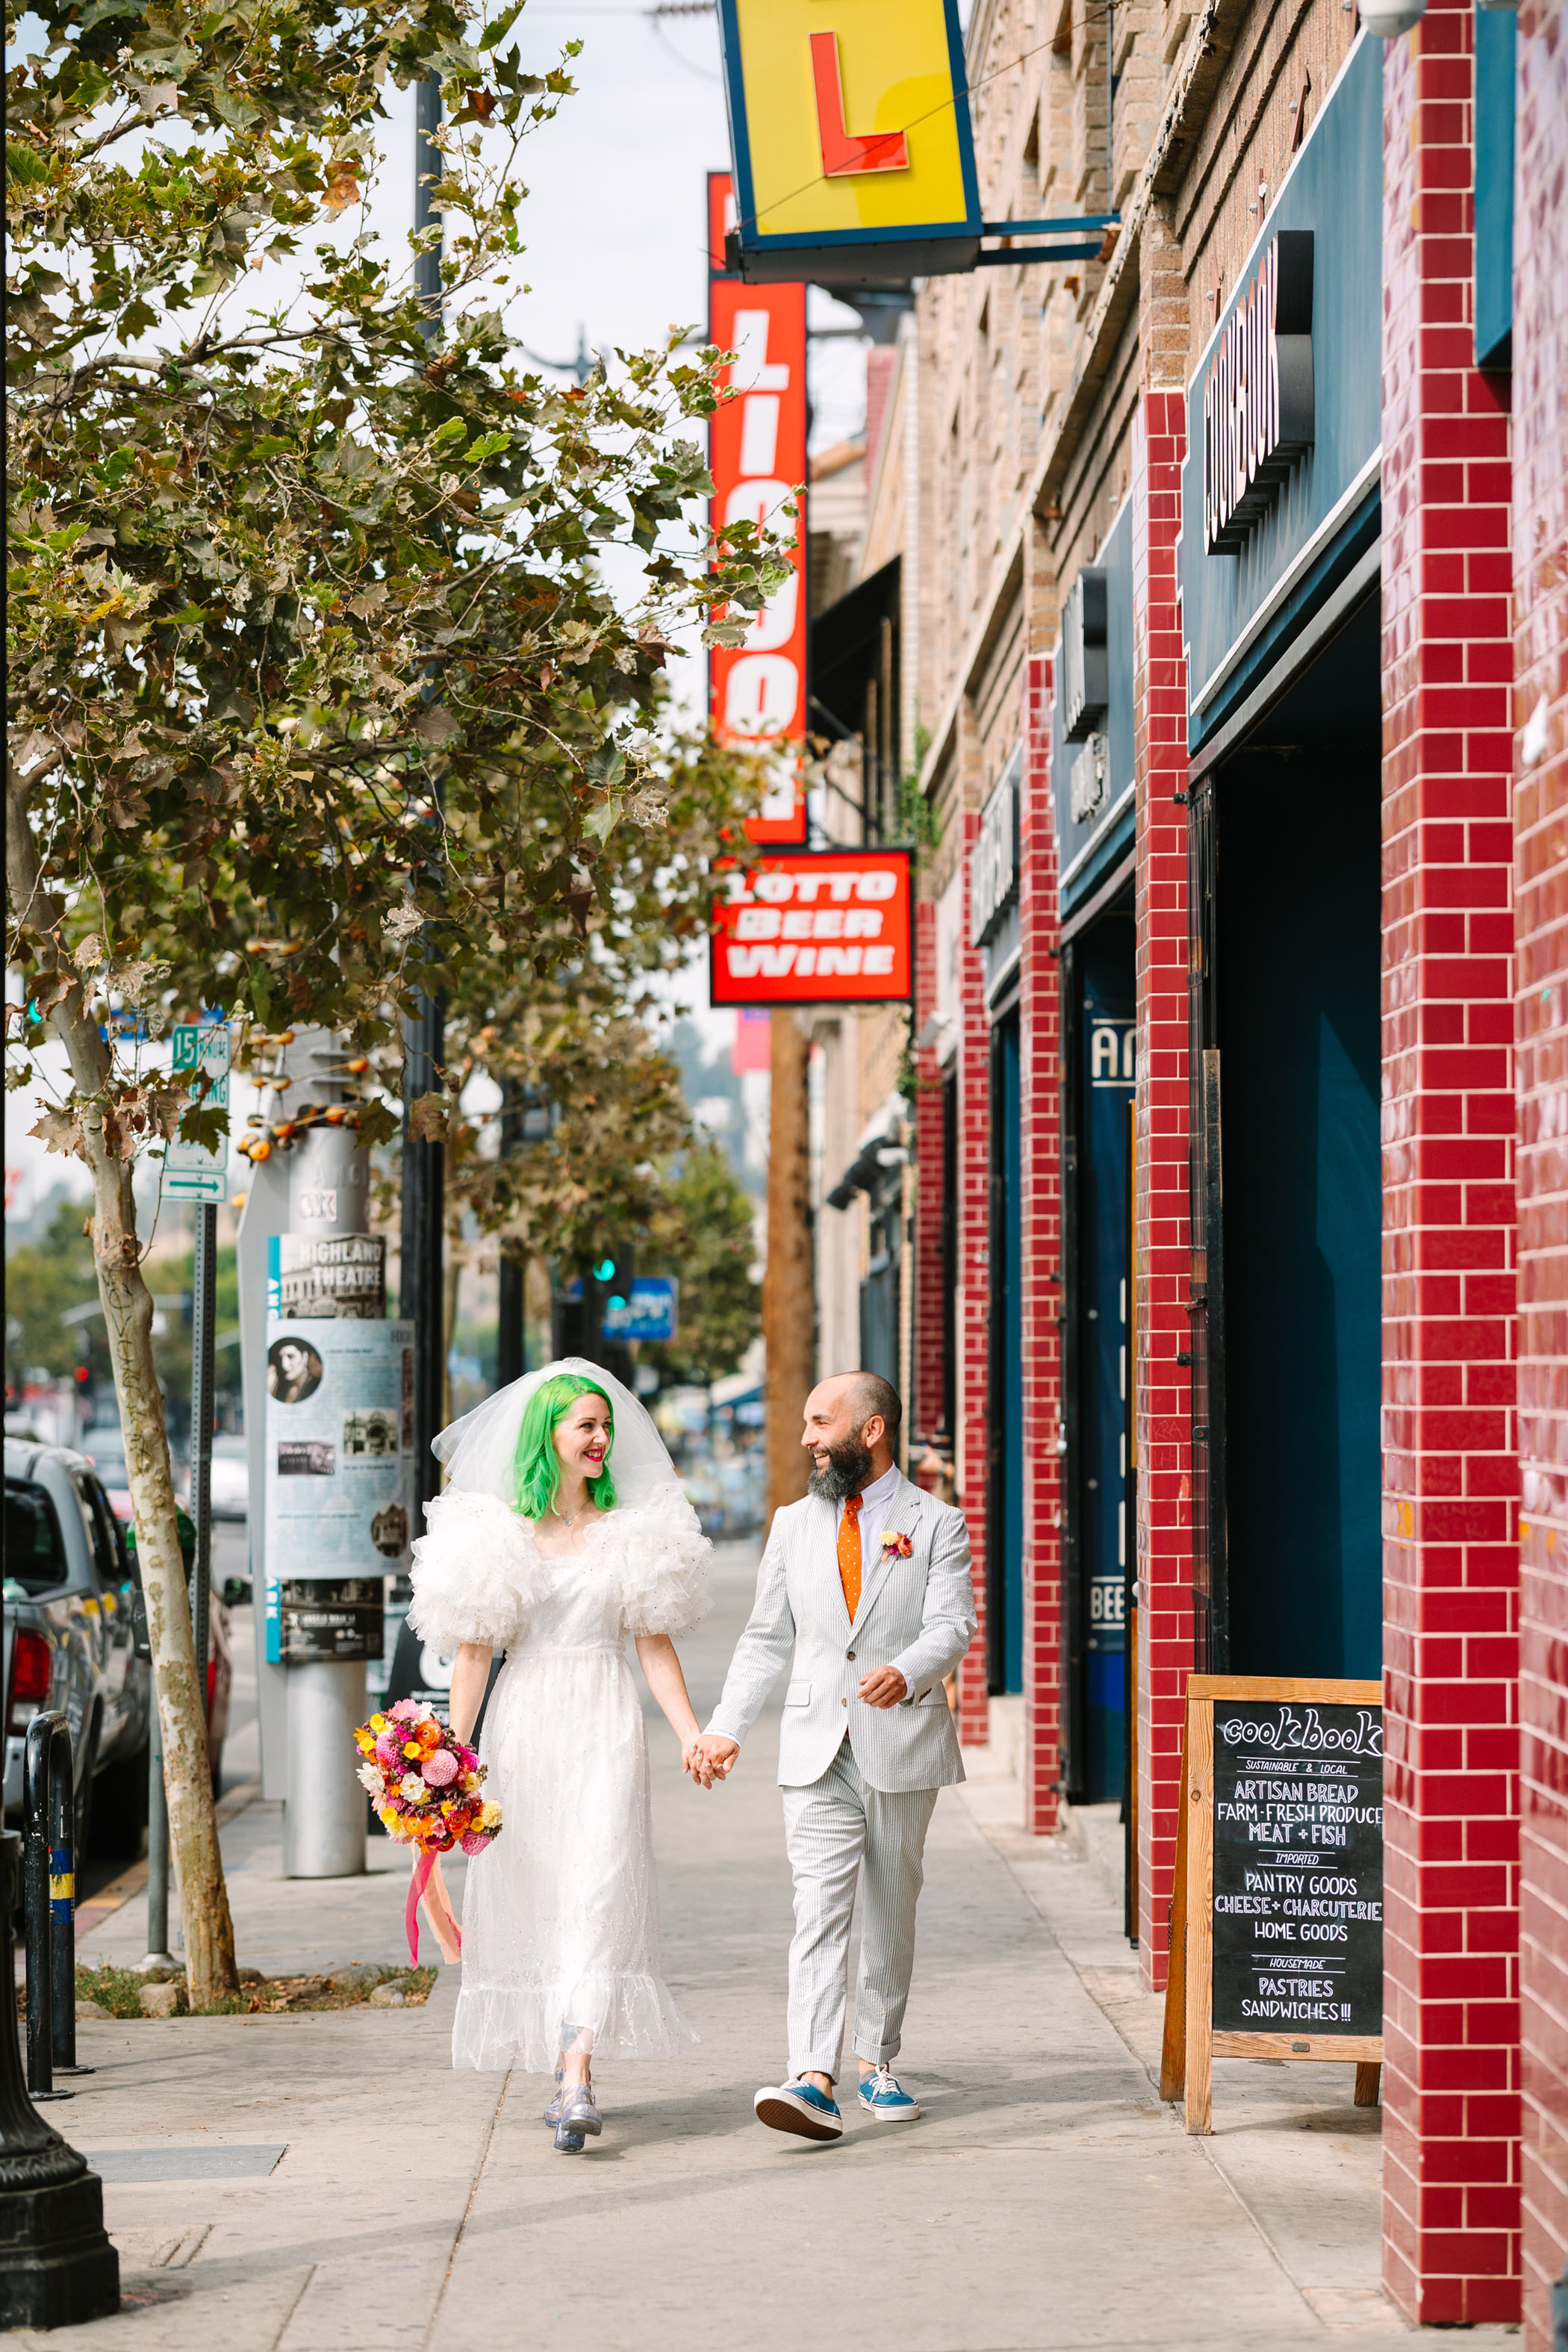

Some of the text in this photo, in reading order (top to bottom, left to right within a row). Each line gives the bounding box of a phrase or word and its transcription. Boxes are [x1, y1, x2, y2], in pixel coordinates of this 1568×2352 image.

[809, 31, 909, 178] L
[1203, 231, 1280, 556] COOKBOOK
[724, 871, 897, 903] LOTTO
[735, 907, 884, 941] BEER
[727, 944, 895, 978] WINE
[176, 1032, 194, 1063] 15
[300, 1242, 382, 1263] HIGHLAND
[311, 1266, 381, 1287] THEATRE
[1090, 1585, 1125, 1620] BEE
[1245, 1760, 1348, 1775] SUSTAINABLE & LOCAL
[1234, 1780, 1359, 1803] ARTISAN BREAD
[1319, 1805, 1384, 1824] PRODUCE
[1248, 1823, 1346, 1846] MEAT + FISH
[1275, 1852, 1319, 1865] IMPORTED
[1245, 1873, 1357, 1895] PANTRY GOODS
[1283, 1899, 1383, 1921] CHARCUTERIE
[1254, 1921, 1348, 1941] HOME GOODS
[1269, 1958, 1326, 1970] HOUSEMADE
[1258, 1977, 1334, 1997] PASTRIES
